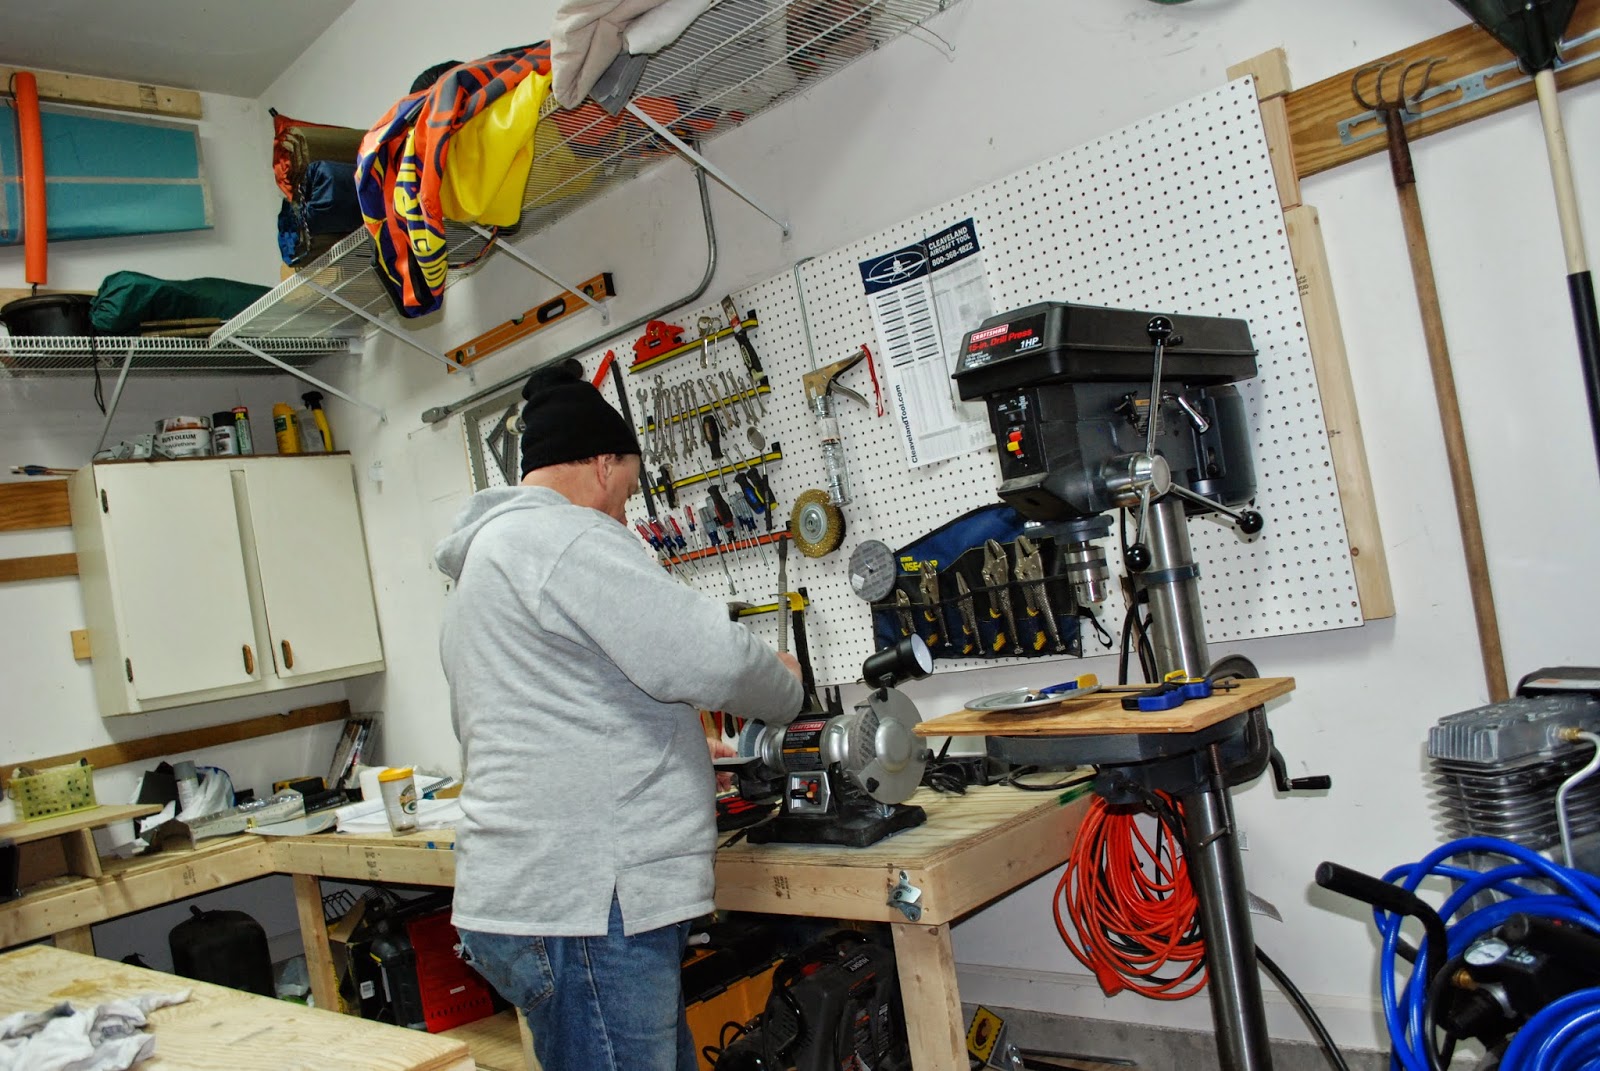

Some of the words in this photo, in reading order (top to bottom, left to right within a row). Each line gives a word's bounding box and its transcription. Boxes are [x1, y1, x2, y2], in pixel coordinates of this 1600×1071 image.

[928, 226, 968, 250] CLEAVELAND
[930, 240, 955, 257] AIRCRAFT
[956, 233, 971, 244] TOOL
[971, 327, 1007, 341] CRAFTSMAN
[990, 335, 1007, 346] Drill
[1008, 329, 1033, 341] Press
[1020, 336, 1040, 348] 1HP
[895, 384, 918, 464] CleavelandTool.com
